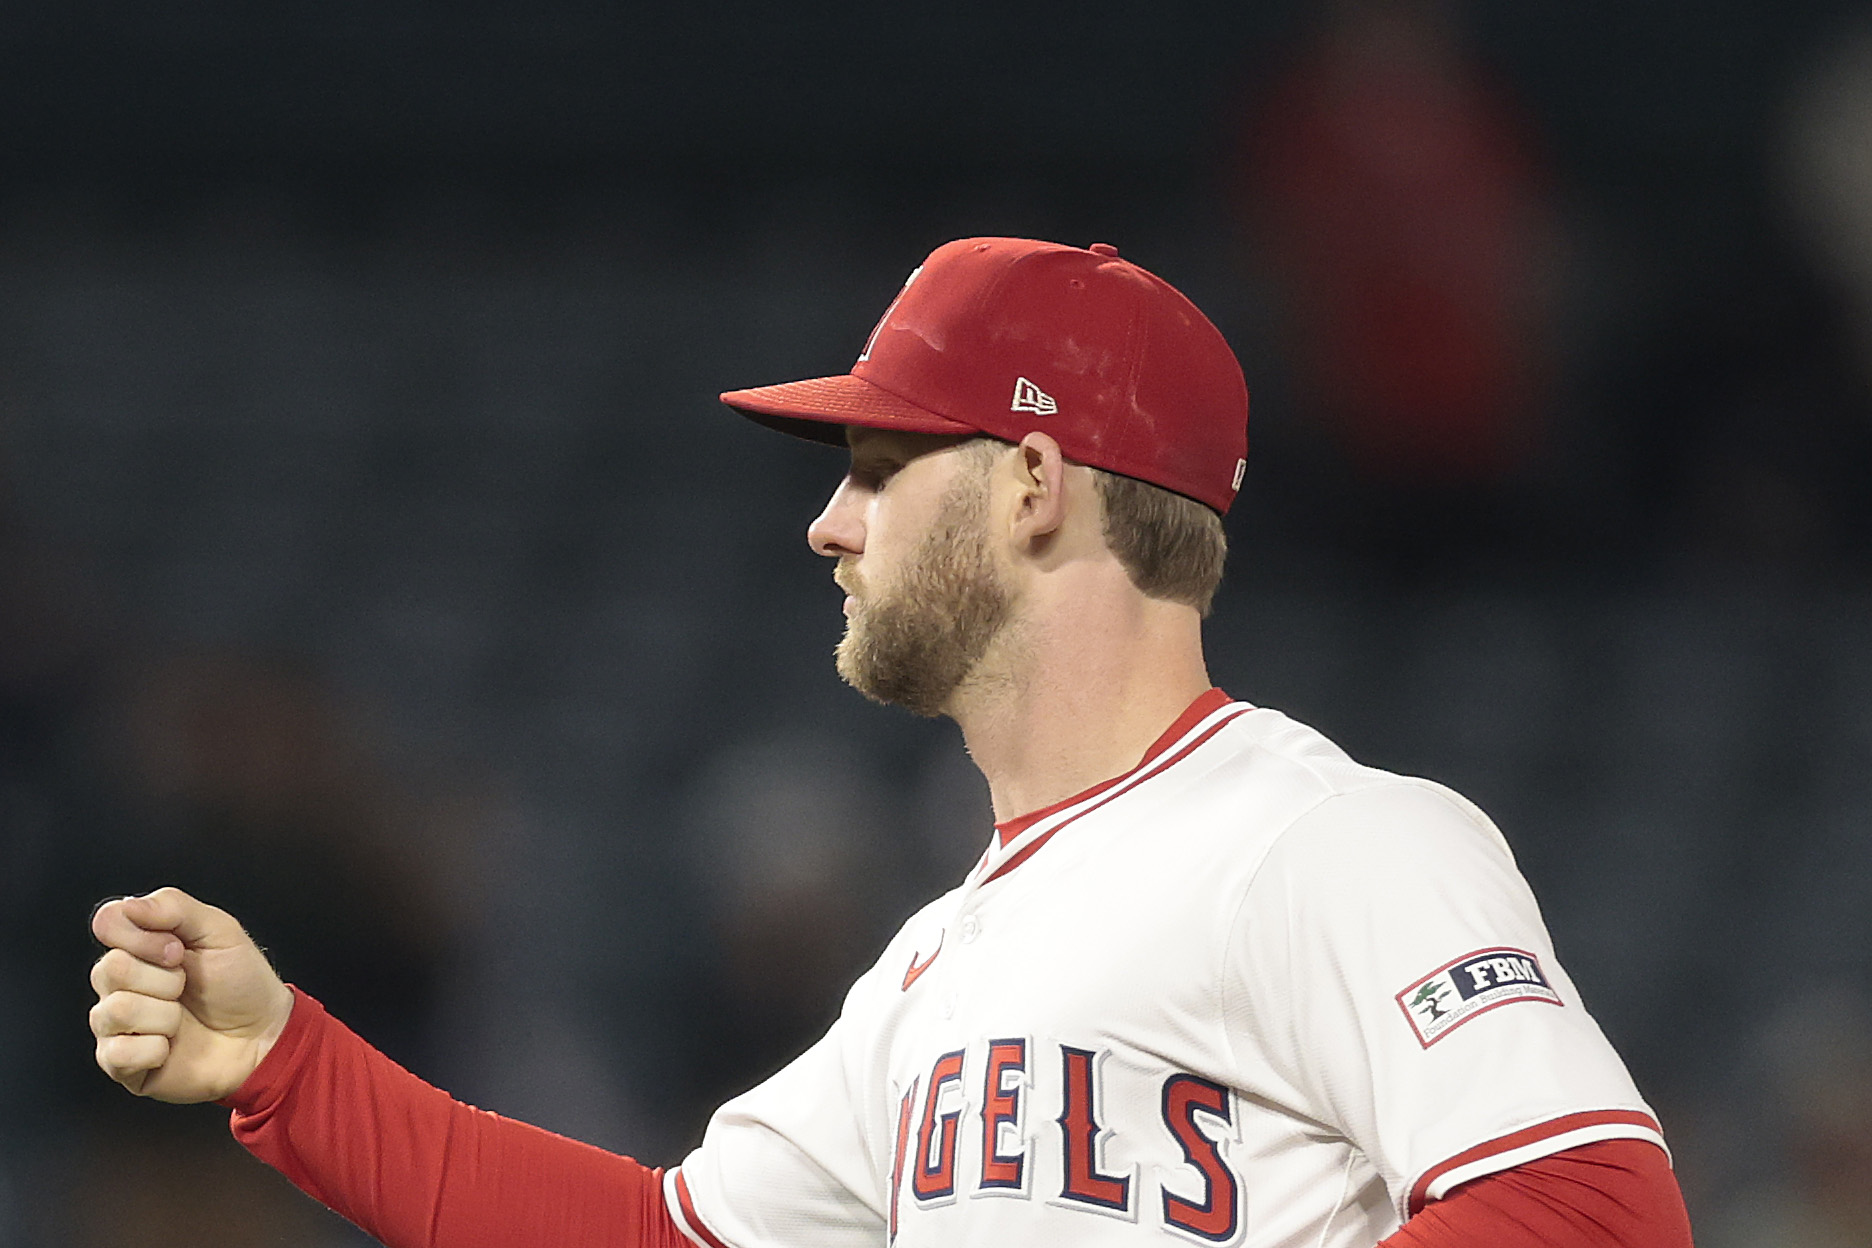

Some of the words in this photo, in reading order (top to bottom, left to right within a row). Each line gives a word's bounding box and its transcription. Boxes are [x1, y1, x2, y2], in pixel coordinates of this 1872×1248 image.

[1464, 956, 1541, 991] FBM
[1423, 1001, 1479, 1038] Foundation
[1479, 986, 1523, 1004] Building
